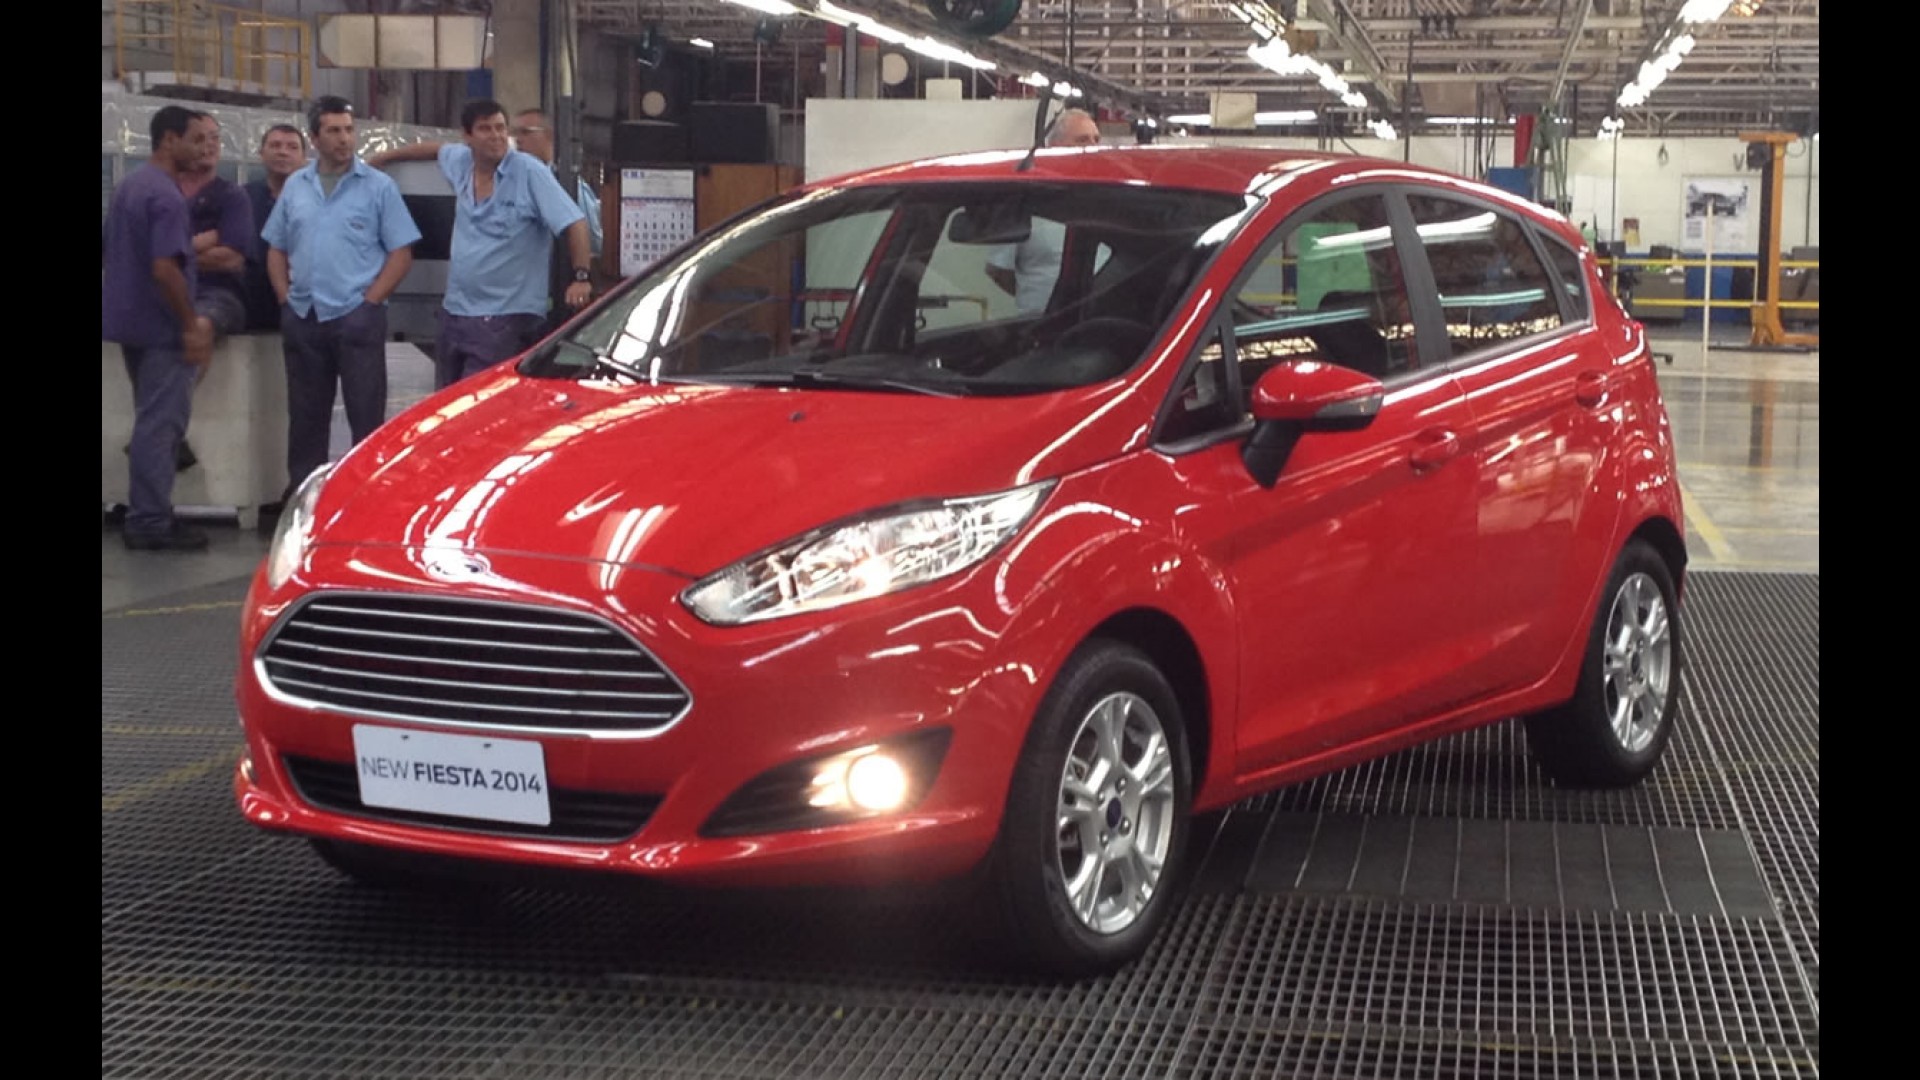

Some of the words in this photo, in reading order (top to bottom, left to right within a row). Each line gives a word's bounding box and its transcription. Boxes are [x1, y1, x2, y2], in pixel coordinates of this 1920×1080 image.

[360, 757, 408, 779] NEW
[413, 762, 487, 788] FIESTA
[491, 770, 542, 794] 2014
